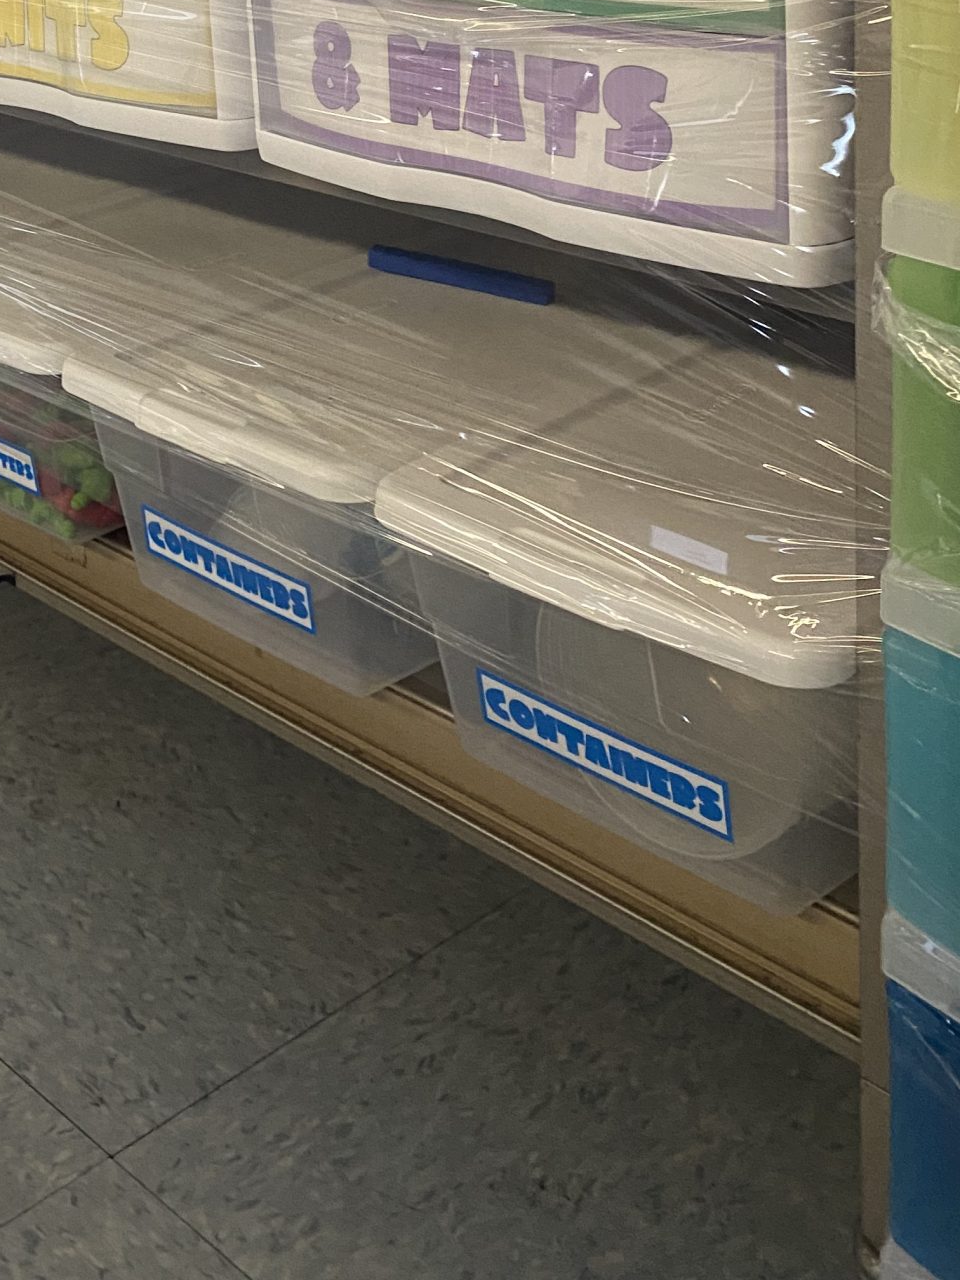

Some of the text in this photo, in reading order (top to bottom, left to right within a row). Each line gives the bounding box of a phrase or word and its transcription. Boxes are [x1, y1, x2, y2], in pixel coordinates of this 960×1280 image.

[387, 33, 673, 172] MATS
[147, 520, 309, 620] CONTAINERS
[486, 687, 725, 823] CONTAINERS
